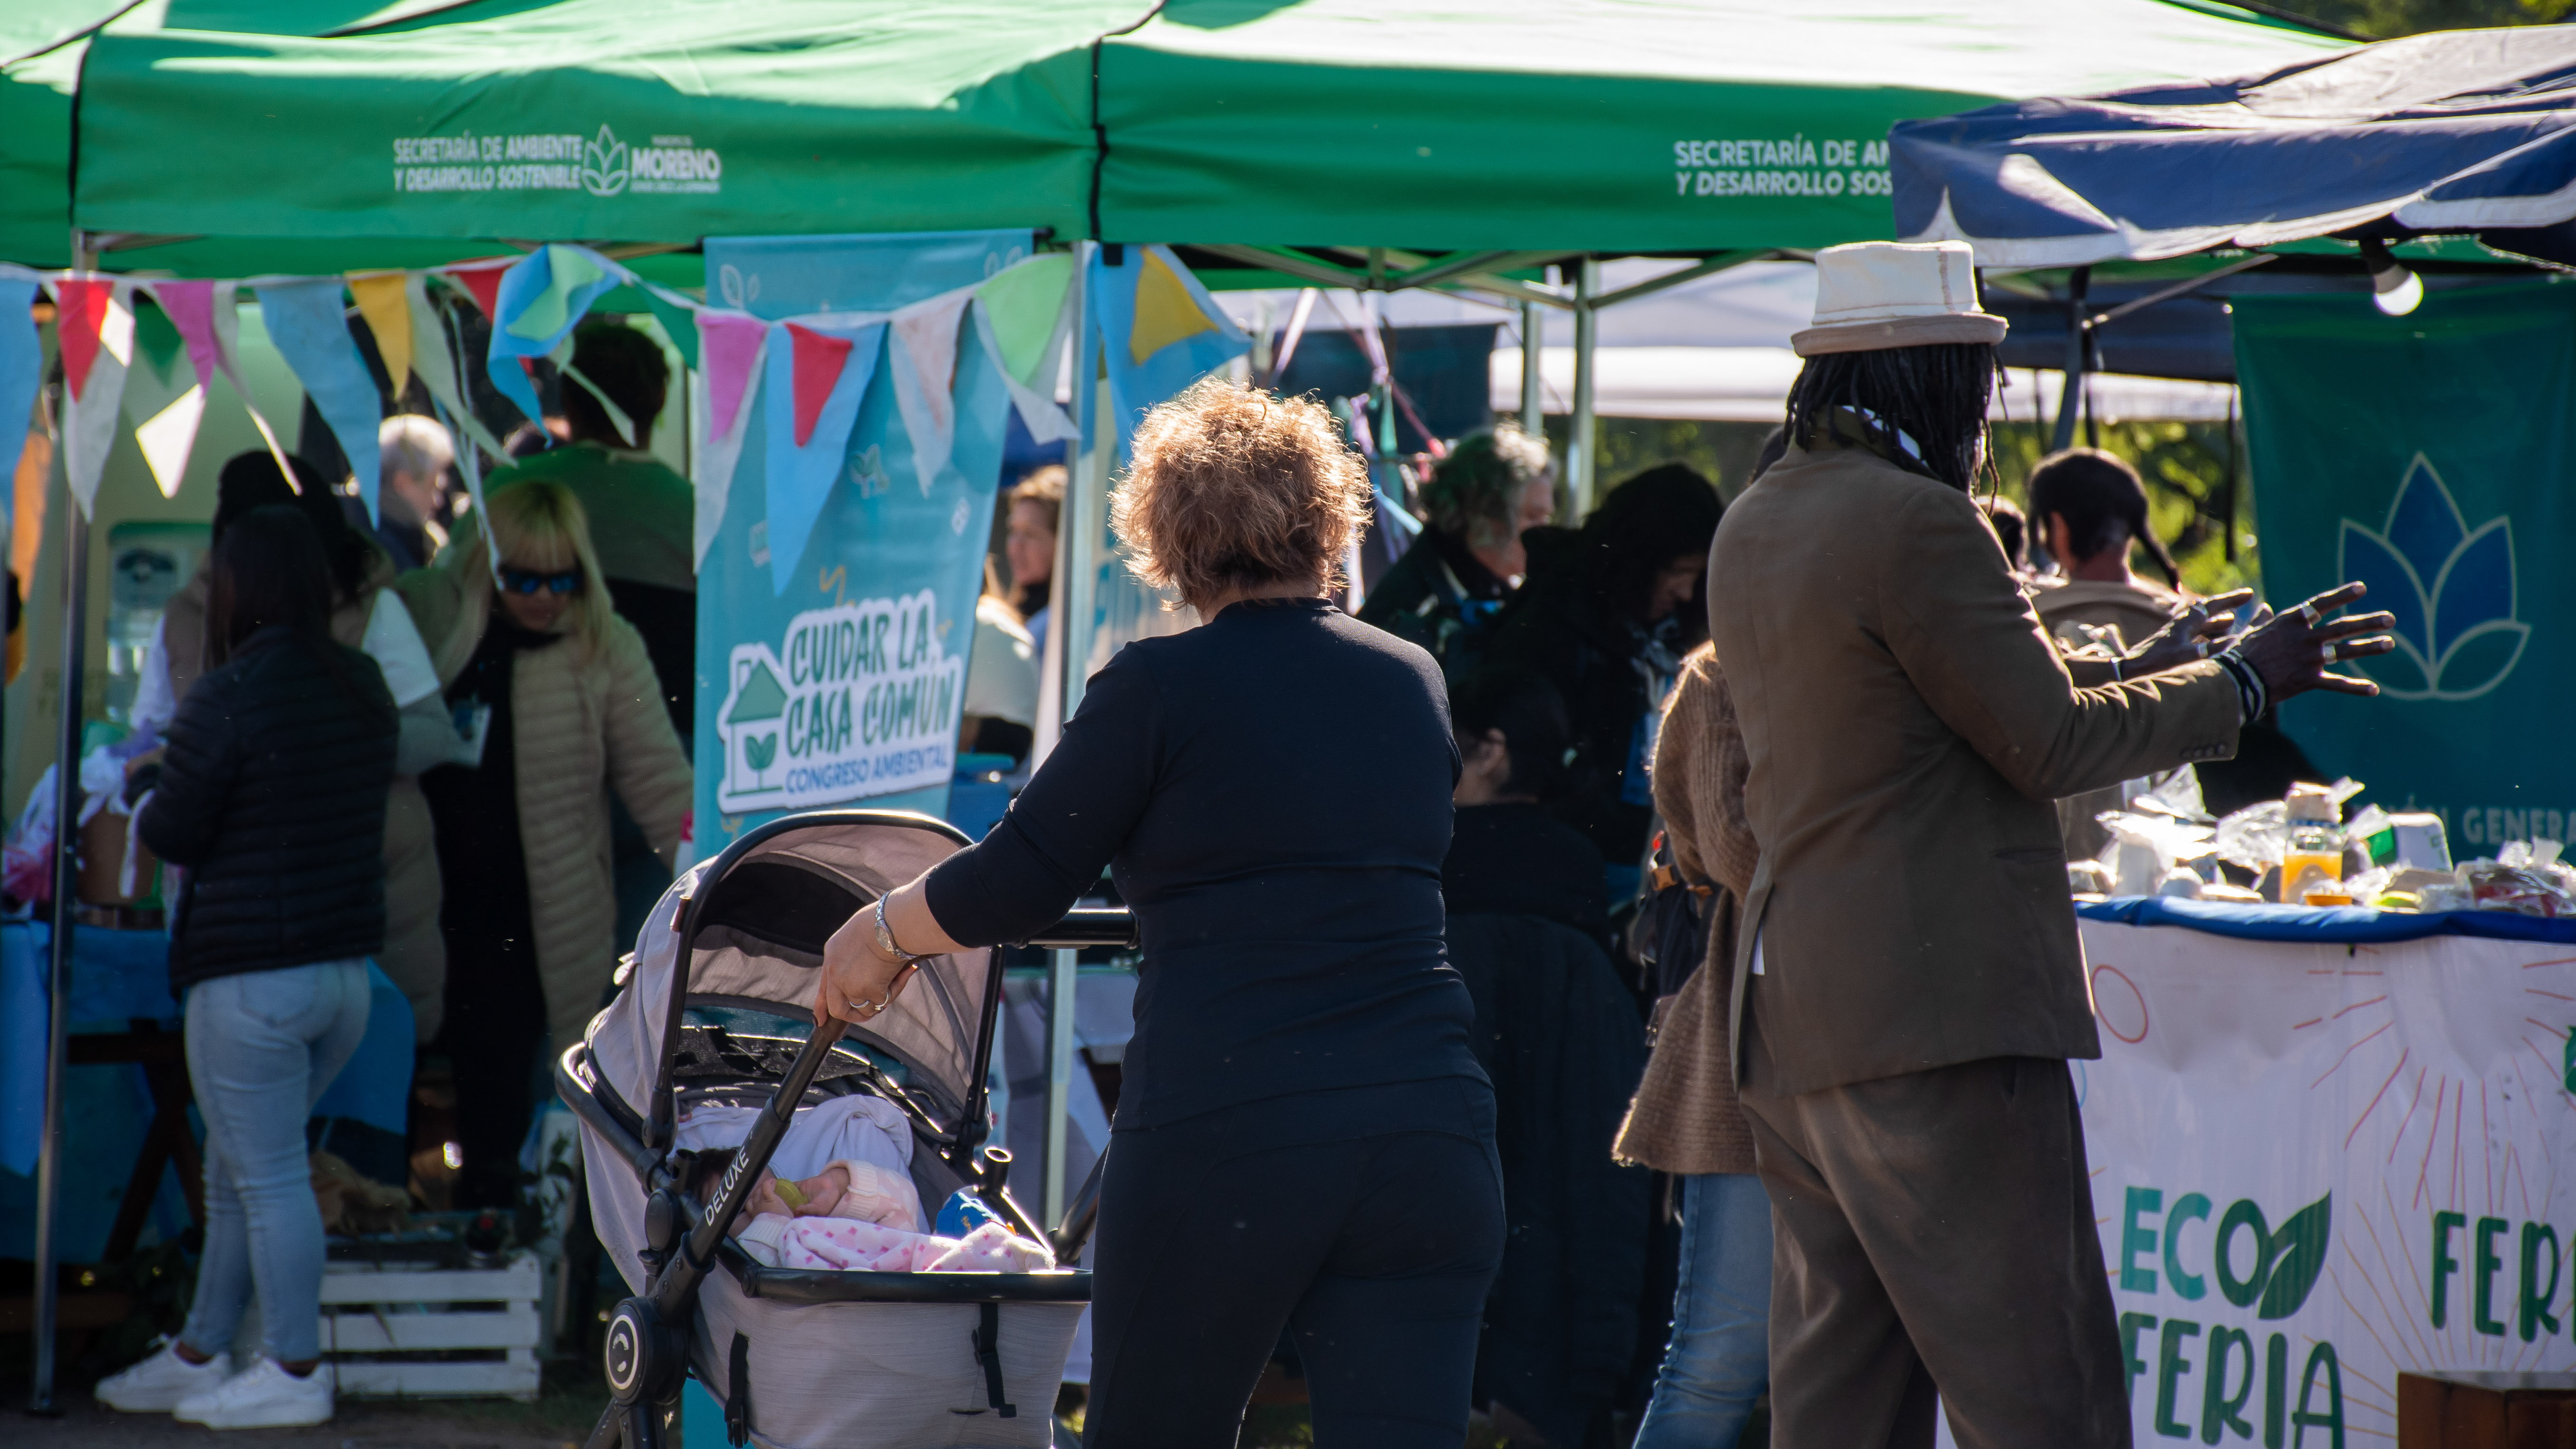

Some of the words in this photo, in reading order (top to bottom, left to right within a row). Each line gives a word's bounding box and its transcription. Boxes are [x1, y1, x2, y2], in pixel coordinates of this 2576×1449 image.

[394, 130, 479, 164] SECRETARÍA
[481, 136, 503, 162] DE
[505, 135, 583, 161] AMBIENTE
[632, 147, 721, 180] MORENO
[1674, 132, 1818, 167] SECRETARÍA
[1823, 139, 1857, 167] DE
[394, 167, 405, 191] Y
[405, 165, 495, 192] DESARROLLO
[497, 164, 581, 189] SOSTENIBLE
[1675, 171, 1692, 196] Y
[1695, 170, 1844, 196] DESARROLLO
[791, 613, 890, 686] CUIDAR
[898, 604, 928, 670] LA
[788, 685, 852, 758] CASA
[786, 758, 869, 794] CONGRESO
[874, 745, 946, 778] AMBIENTAL
[705, 1146, 749, 1227] DELUXE
[2120, 1186, 2274, 1308] ECO
[2431, 1210, 2576, 1344] FER
[2120, 1311, 2346, 1449] FERIA
